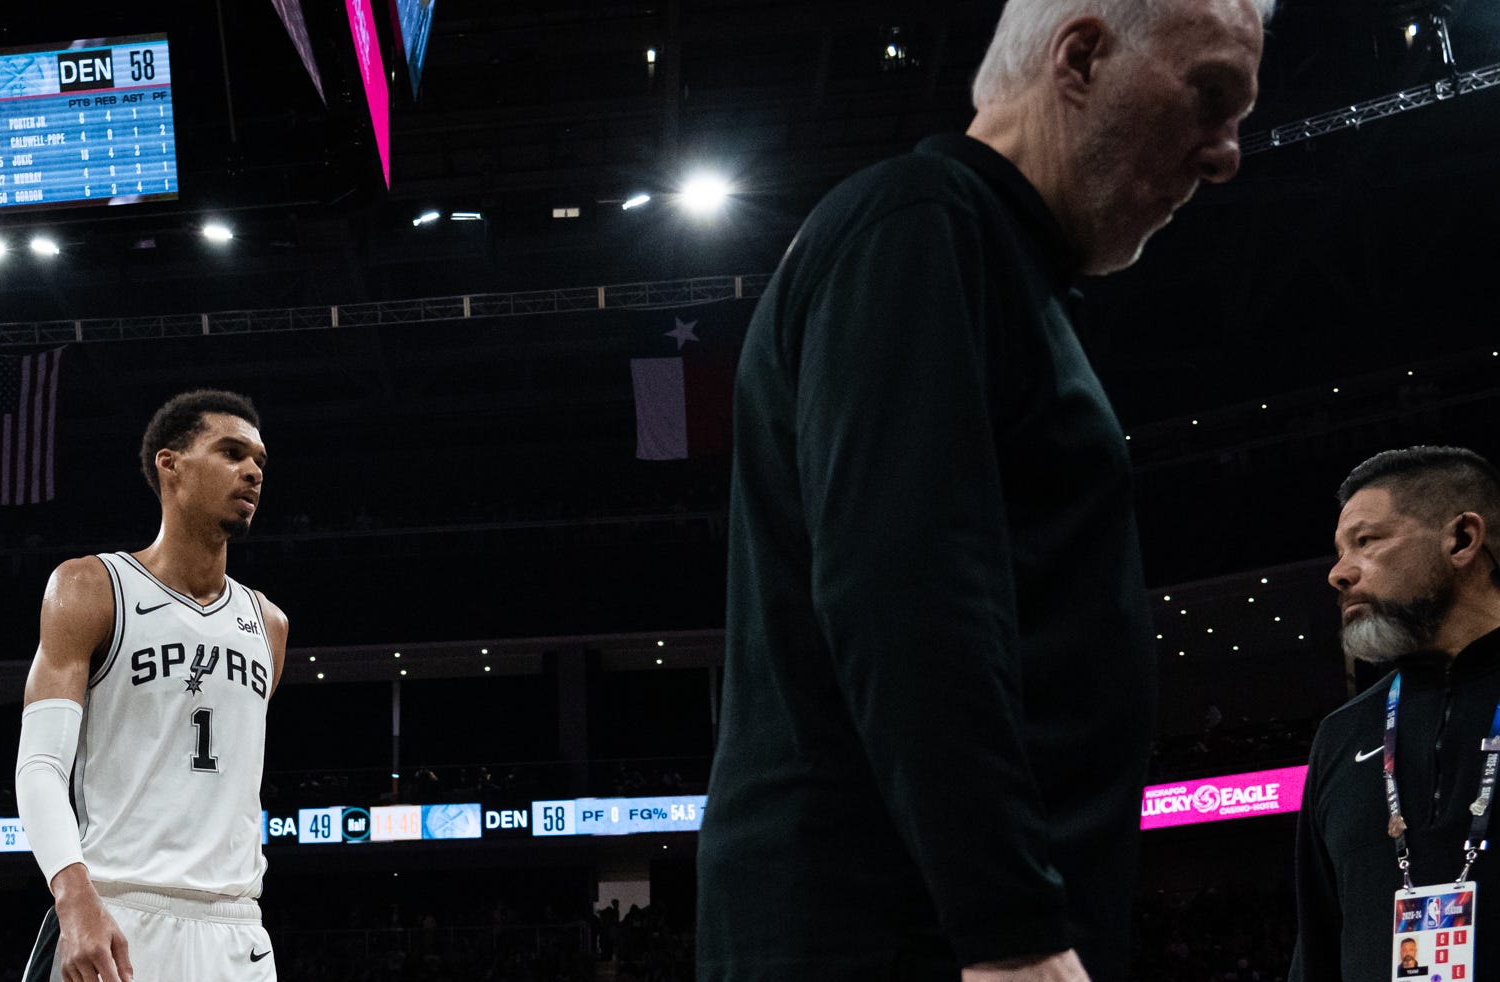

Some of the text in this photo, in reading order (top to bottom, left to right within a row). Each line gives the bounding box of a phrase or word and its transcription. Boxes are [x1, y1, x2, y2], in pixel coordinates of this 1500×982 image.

[59, 49, 155, 84] DEN 58
[68, 91, 167, 108] PTS REB AST PF
[12, 154, 33, 166] JOKIC
[236, 617, 261, 637] Self.
[131, 642, 268, 700] SPURS
[190, 707, 220, 773] 1
[1141, 783, 1280, 817] LUCKY EAGLE
[269, 817, 297, 836] SA
[309, 814, 331, 839] 49
[375, 811, 420, 835] 14:46
[485, 810, 528, 829] DEN
[543, 806, 565, 832] 58
[582, 810, 604, 822] PF
[611, 806, 619, 823] 0
[629, 808, 668, 820] FG%
[670, 803, 696, 820] 54.5
[5, 833, 16, 845] 23
